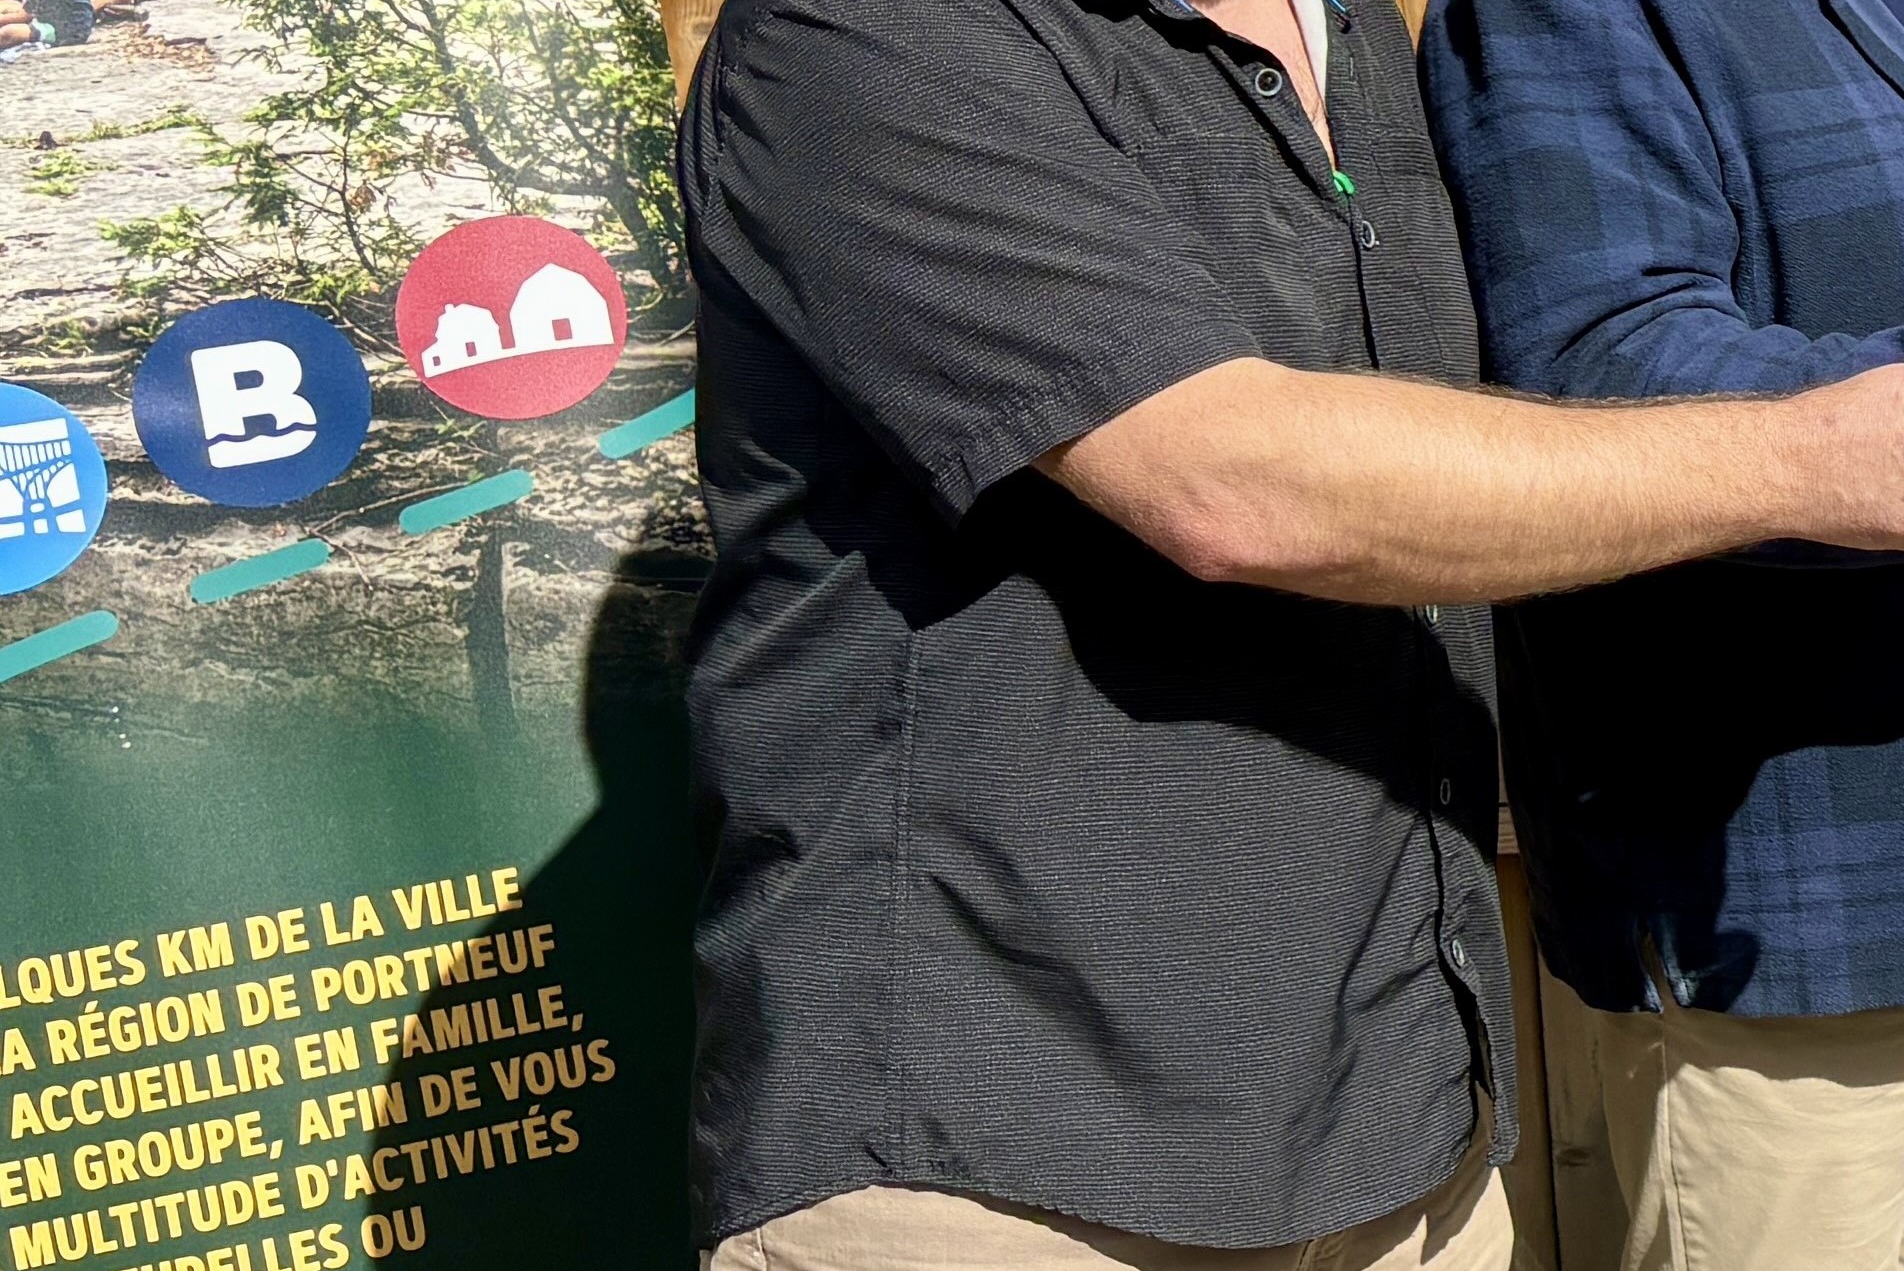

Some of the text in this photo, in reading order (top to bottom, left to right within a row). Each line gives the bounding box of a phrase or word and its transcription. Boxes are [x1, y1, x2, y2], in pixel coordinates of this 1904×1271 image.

[157, 925, 234, 978] KM
[245, 907, 306, 959] DE
[320, 895, 384, 946] LA
[392, 867, 522, 932] VILLE
[0, 925, 555, 1078] A RÉGION DE PORTNEUF
[9, 985, 584, 1139] ACCUEILLIR EN FAMILLE,
[0, 1039, 617, 1208] EN GROUPE, AFIN DE VOUS
[9, 1108, 581, 1271] MULTITUDE D'ACTIVITÉS
[361, 1206, 427, 1259] OU
